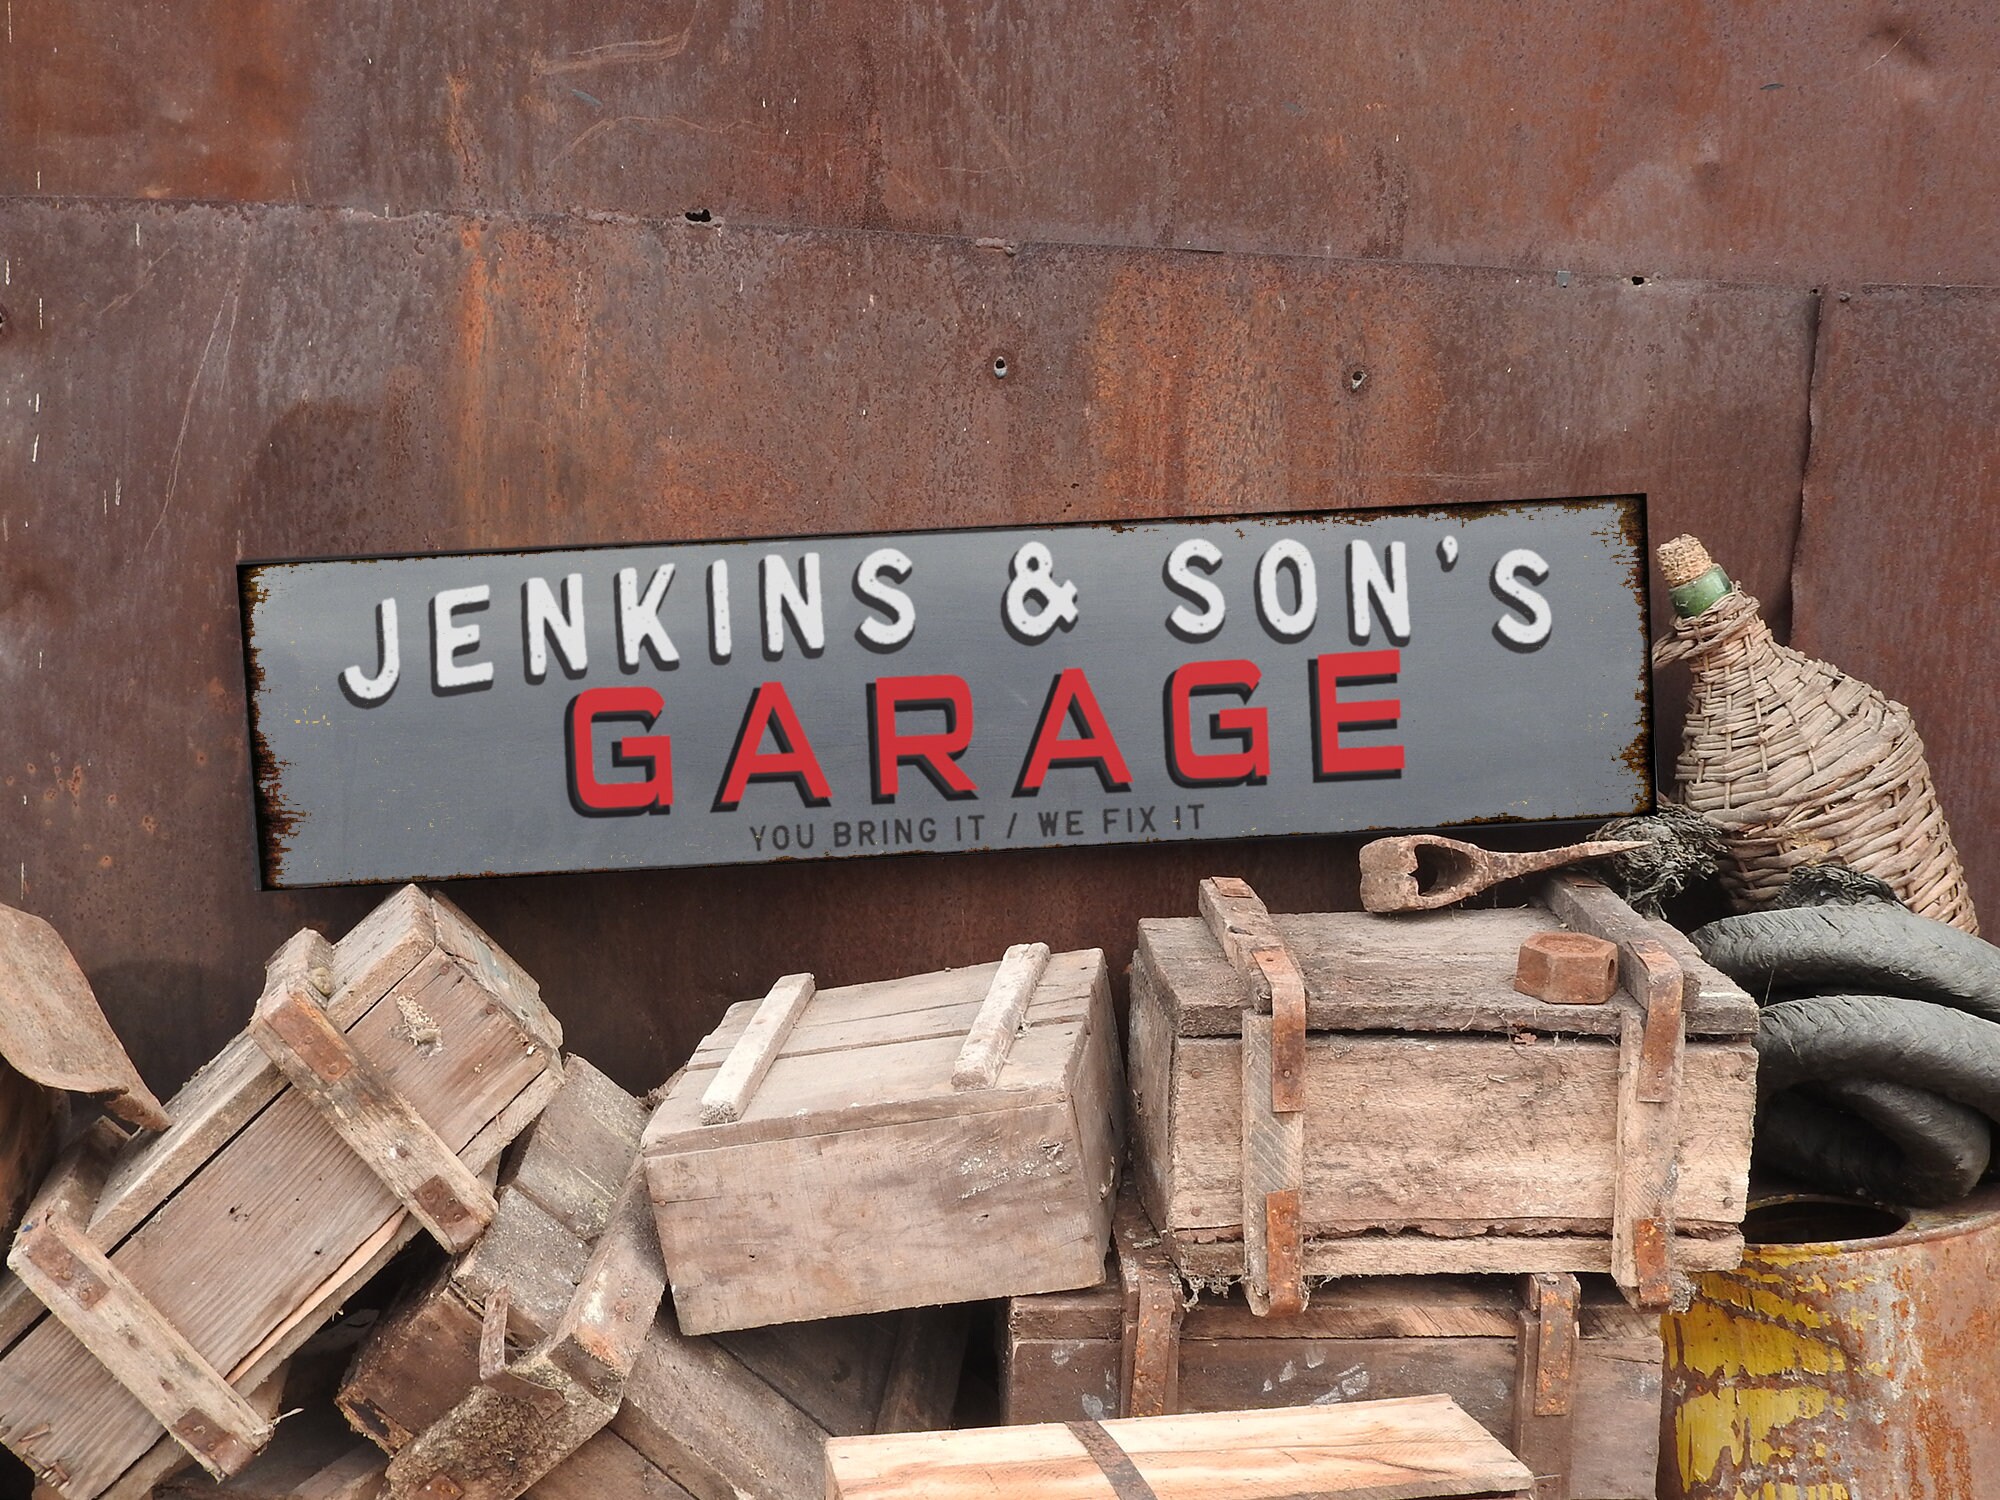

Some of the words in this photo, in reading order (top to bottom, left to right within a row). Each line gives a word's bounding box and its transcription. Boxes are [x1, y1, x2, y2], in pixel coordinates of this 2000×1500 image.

[341, 548, 916, 704] JENKINS
[1004, 541, 1079, 641] &
[1164, 535, 1553, 648] SON'S
[567, 650, 1405, 814] GARAGE
[749, 822, 815, 851] YOU
[833, 817, 937, 848] BRING
[956, 814, 985, 842] IT
[1006, 812, 1018, 839] /
[1038, 809, 1084, 837] WE
[1103, 806, 1157, 834] FIX
[1174, 804, 1205, 831] IT
